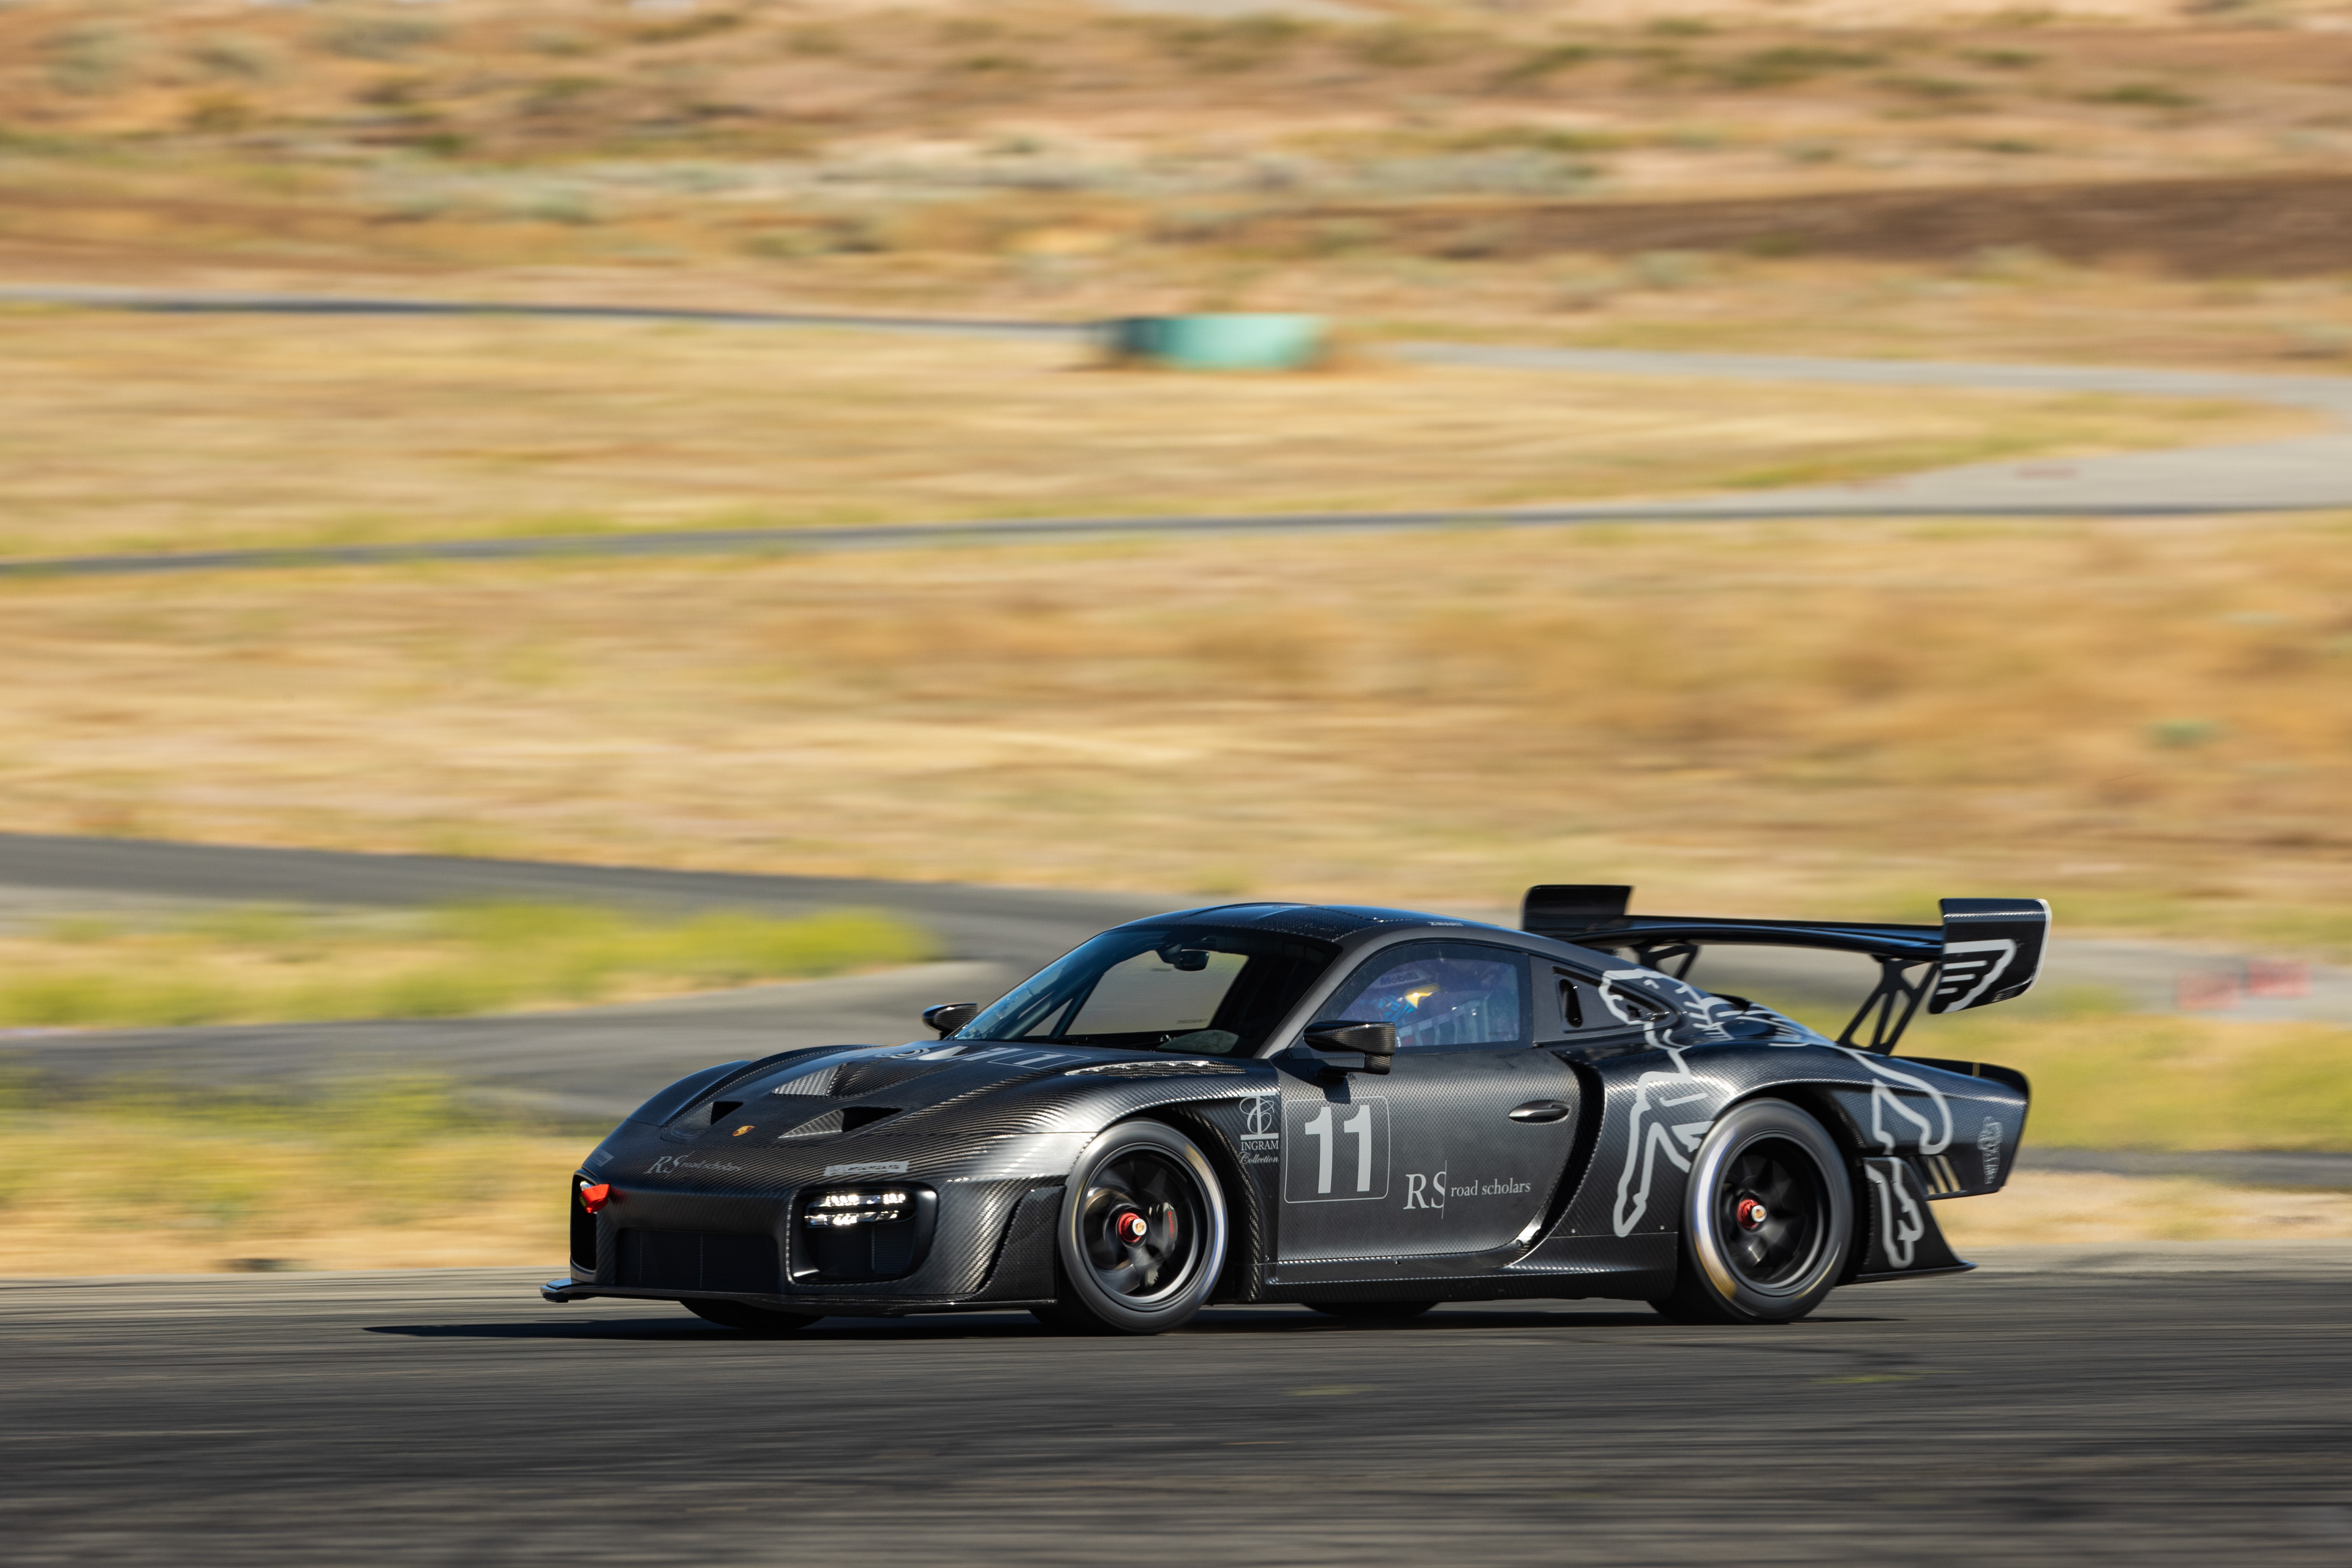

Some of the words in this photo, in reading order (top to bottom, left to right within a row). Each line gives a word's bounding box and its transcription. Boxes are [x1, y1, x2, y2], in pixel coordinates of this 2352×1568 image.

[1238, 1152, 1280, 1164] Collection
[1240, 1140, 1280, 1151] INGRAM
[1305, 1105, 1372, 1194] 11
[1403, 1170, 1447, 1210] RS
[1450, 1180, 1478, 1197] road
[1482, 1178, 1531, 1196] scholars
